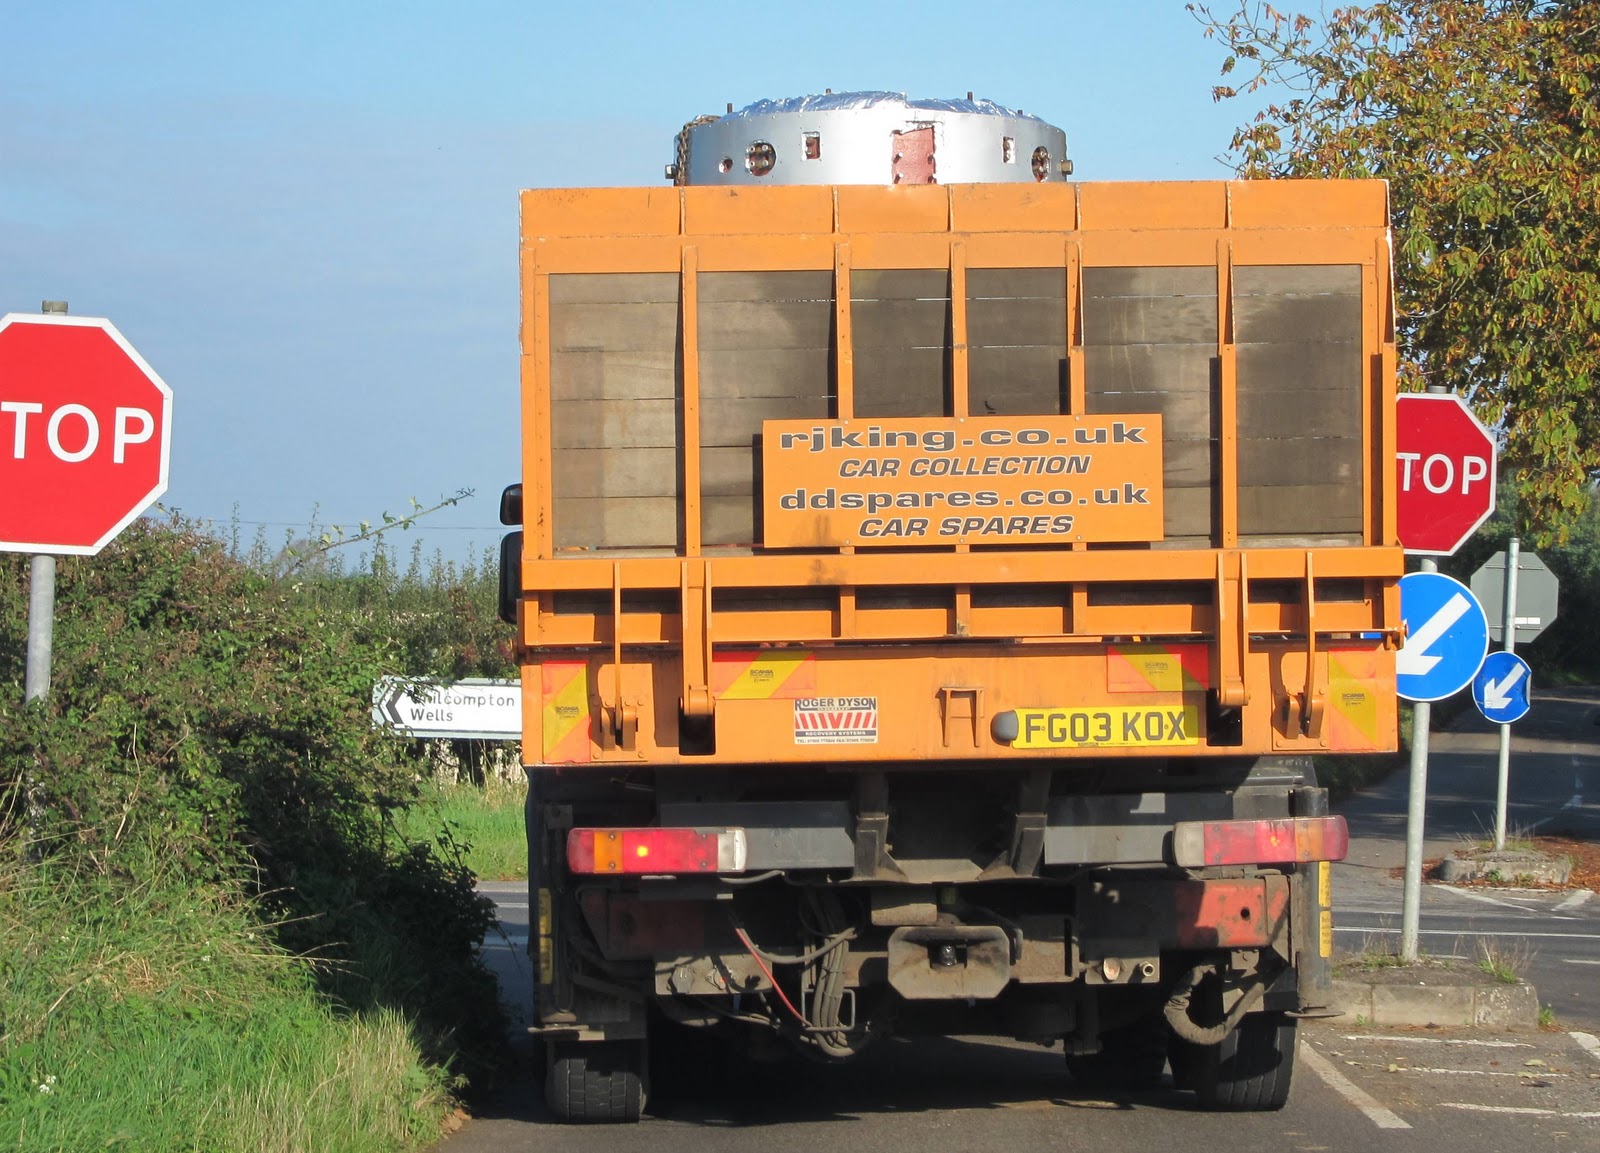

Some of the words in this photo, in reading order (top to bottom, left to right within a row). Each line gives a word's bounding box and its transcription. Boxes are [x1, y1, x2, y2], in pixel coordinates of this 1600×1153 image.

[0, 401, 155, 464] TOP
[780, 422, 1149, 452] rjking.co.uk
[838, 458, 900, 478] CAR
[909, 454, 1091, 477] COLLECTION
[1397, 452, 1487, 495] TOP
[780, 483, 1151, 514] ddspares.co.uk
[858, 517, 929, 537] CAR
[938, 515, 1074, 535] SPARES
[414, 692, 515, 707] ilcompton
[795, 698, 835, 711] ROGER
[838, 698, 876, 710] DYSON
[410, 708, 453, 722] Wells
[1025, 712, 1112, 743] FG03
[1122, 711, 1187, 742] KOX
